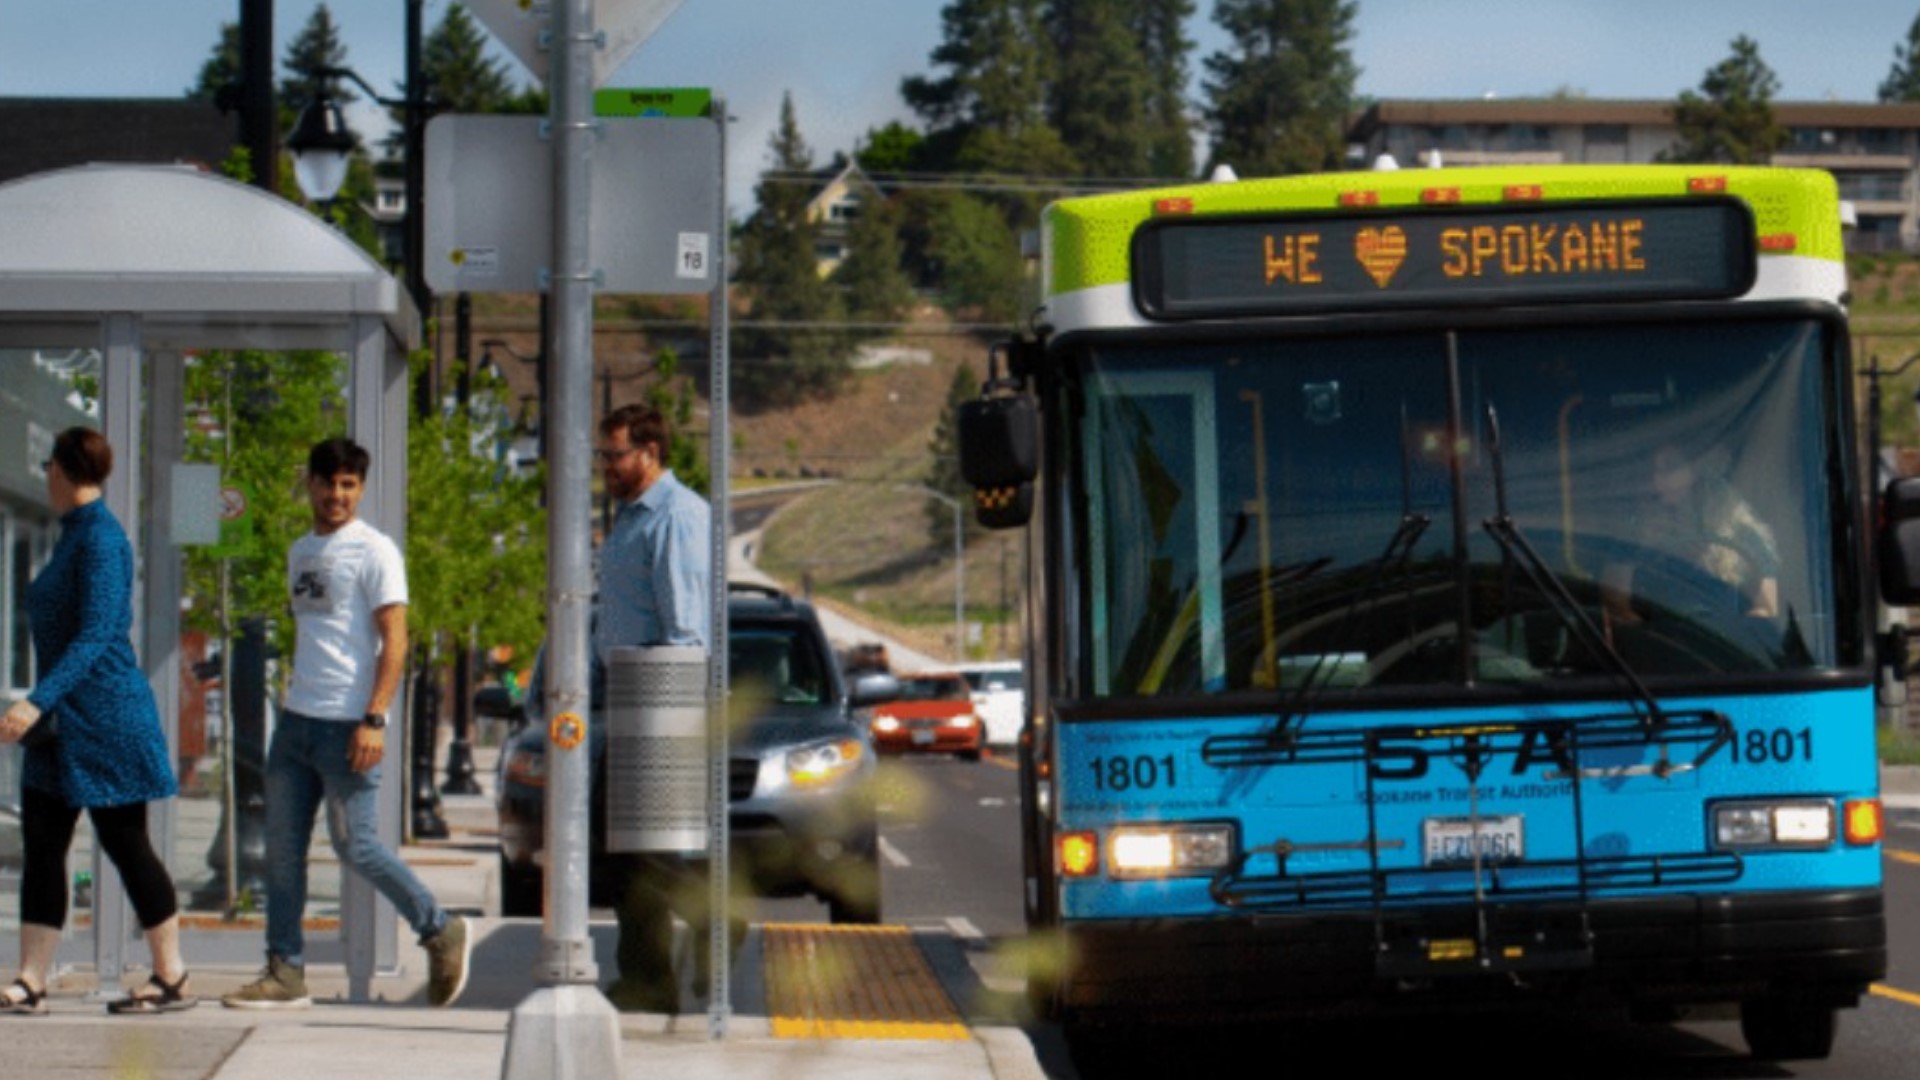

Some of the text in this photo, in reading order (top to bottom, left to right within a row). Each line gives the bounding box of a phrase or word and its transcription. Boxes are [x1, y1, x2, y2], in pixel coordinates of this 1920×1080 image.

[1264, 219, 1646, 286] WE SPOKANE
[1728, 726, 1813, 764] 1801
[1089, 754, 1176, 792] 1801
